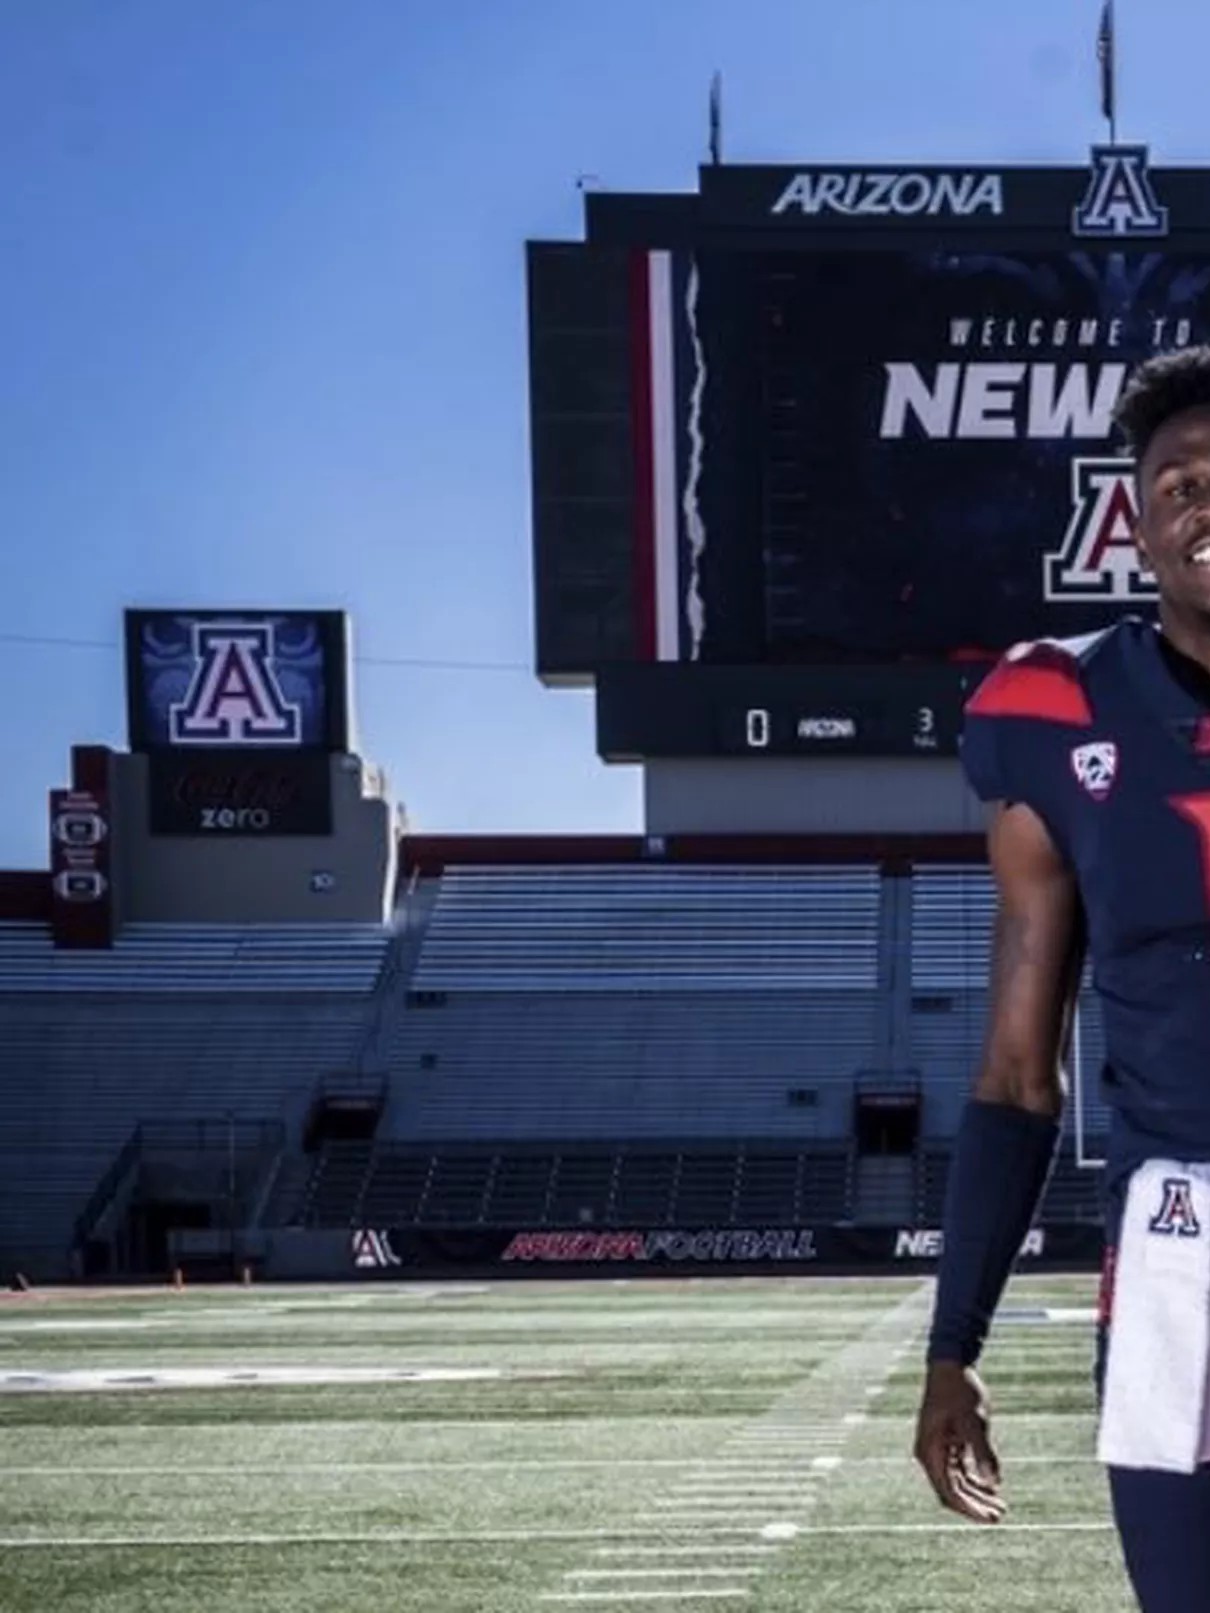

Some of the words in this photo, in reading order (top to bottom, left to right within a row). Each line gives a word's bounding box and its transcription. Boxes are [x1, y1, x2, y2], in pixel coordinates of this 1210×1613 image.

[771, 173, 1003, 215] ARIZONA
[1072, 146, 1167, 236] A
[949, 318, 1124, 347] WELCOME
[1151, 319, 1191, 345] TO
[879, 362, 1127, 438] NEW
[169, 623, 301, 743] A
[918, 707, 933, 732] 3
[201, 807, 270, 829] zero
[1149, 1178, 1200, 1236] A
[895, 1229, 945, 1257] NE
